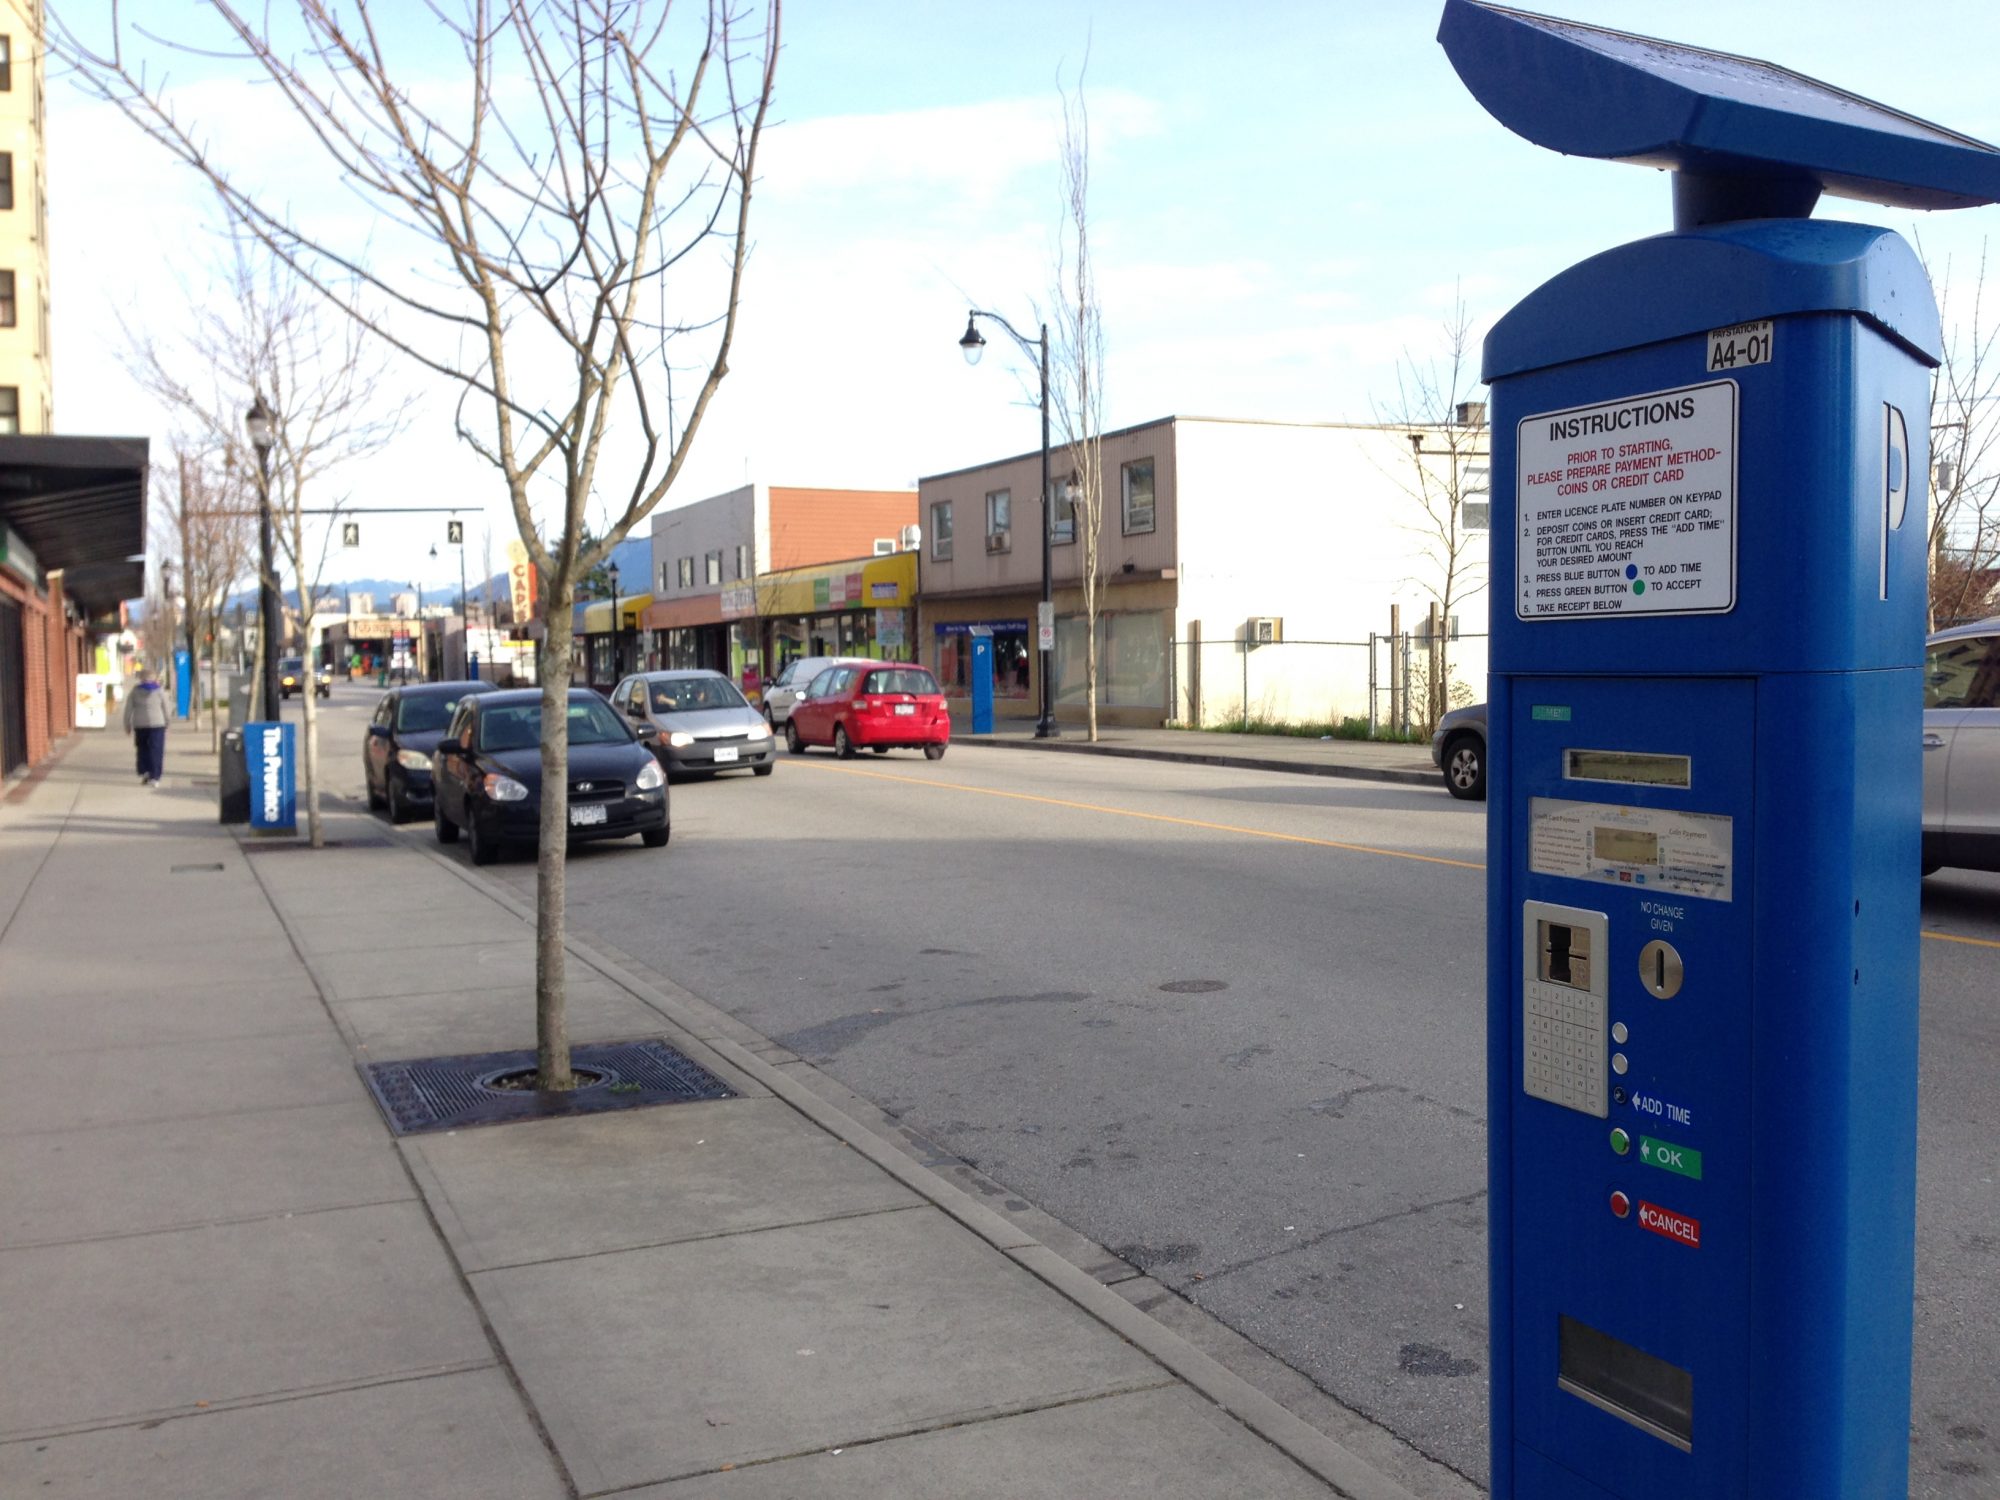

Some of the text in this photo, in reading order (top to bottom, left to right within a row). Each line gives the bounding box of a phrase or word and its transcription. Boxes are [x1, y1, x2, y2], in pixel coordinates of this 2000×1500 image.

[1711, 334, 1769, 370] A4-01
[1550, 397, 1695, 441] INSTRUCTIONS
[1568, 438, 1673, 465] PRIOR TO STARTING,
[1527, 447, 1721, 486] PLEASE PREPARE PAYMENT METHOD-
[1557, 468, 1684, 496] COINS OR CREDIT CARD
[1524, 490, 1722, 522] 1. ENTER LICENCE PLATE NUMBER ON KEYPAD
[1524, 529, 1531, 537] 2.
[1537, 524, 1569, 535] DEPOSIT
[1572, 521, 1597, 532] COINS
[1601, 520, 1612, 529] OR
[1616, 515, 1646, 527] INSERT
[1649, 512, 1681, 524] CREDIT
[1537, 537, 1552, 546] FOR
[1556, 533, 1583, 544] CREDIT
[1586, 530, 1617, 541] CARDS,
[1620, 527, 1648, 538] PRESS
[1651, 525, 1668, 535] THE
[1537, 539, 1644, 557] BUTTON UNTIL YOU REACH
[1537, 552, 1632, 568] YOUR DESIRED AMOUNT
[1524, 562, 1702, 584] 3. PRESS BLUE BUTTON TO ADD TIME
[1524, 579, 1702, 598] 4. PRESS GREEN BUTTON TO ACCEPT
[1524, 600, 1623, 613] 5. TAKE RECEIPT BELOW
[263, 726, 282, 822] The Province
[1640, 902, 1684, 920] NO CHANGE
[1650, 918, 1673, 932] GIVEN
[1641, 1096, 1691, 1125] ADD TIME
[1656, 1147, 1683, 1169] OK
[1648, 1210, 1698, 1242] CANCEL
